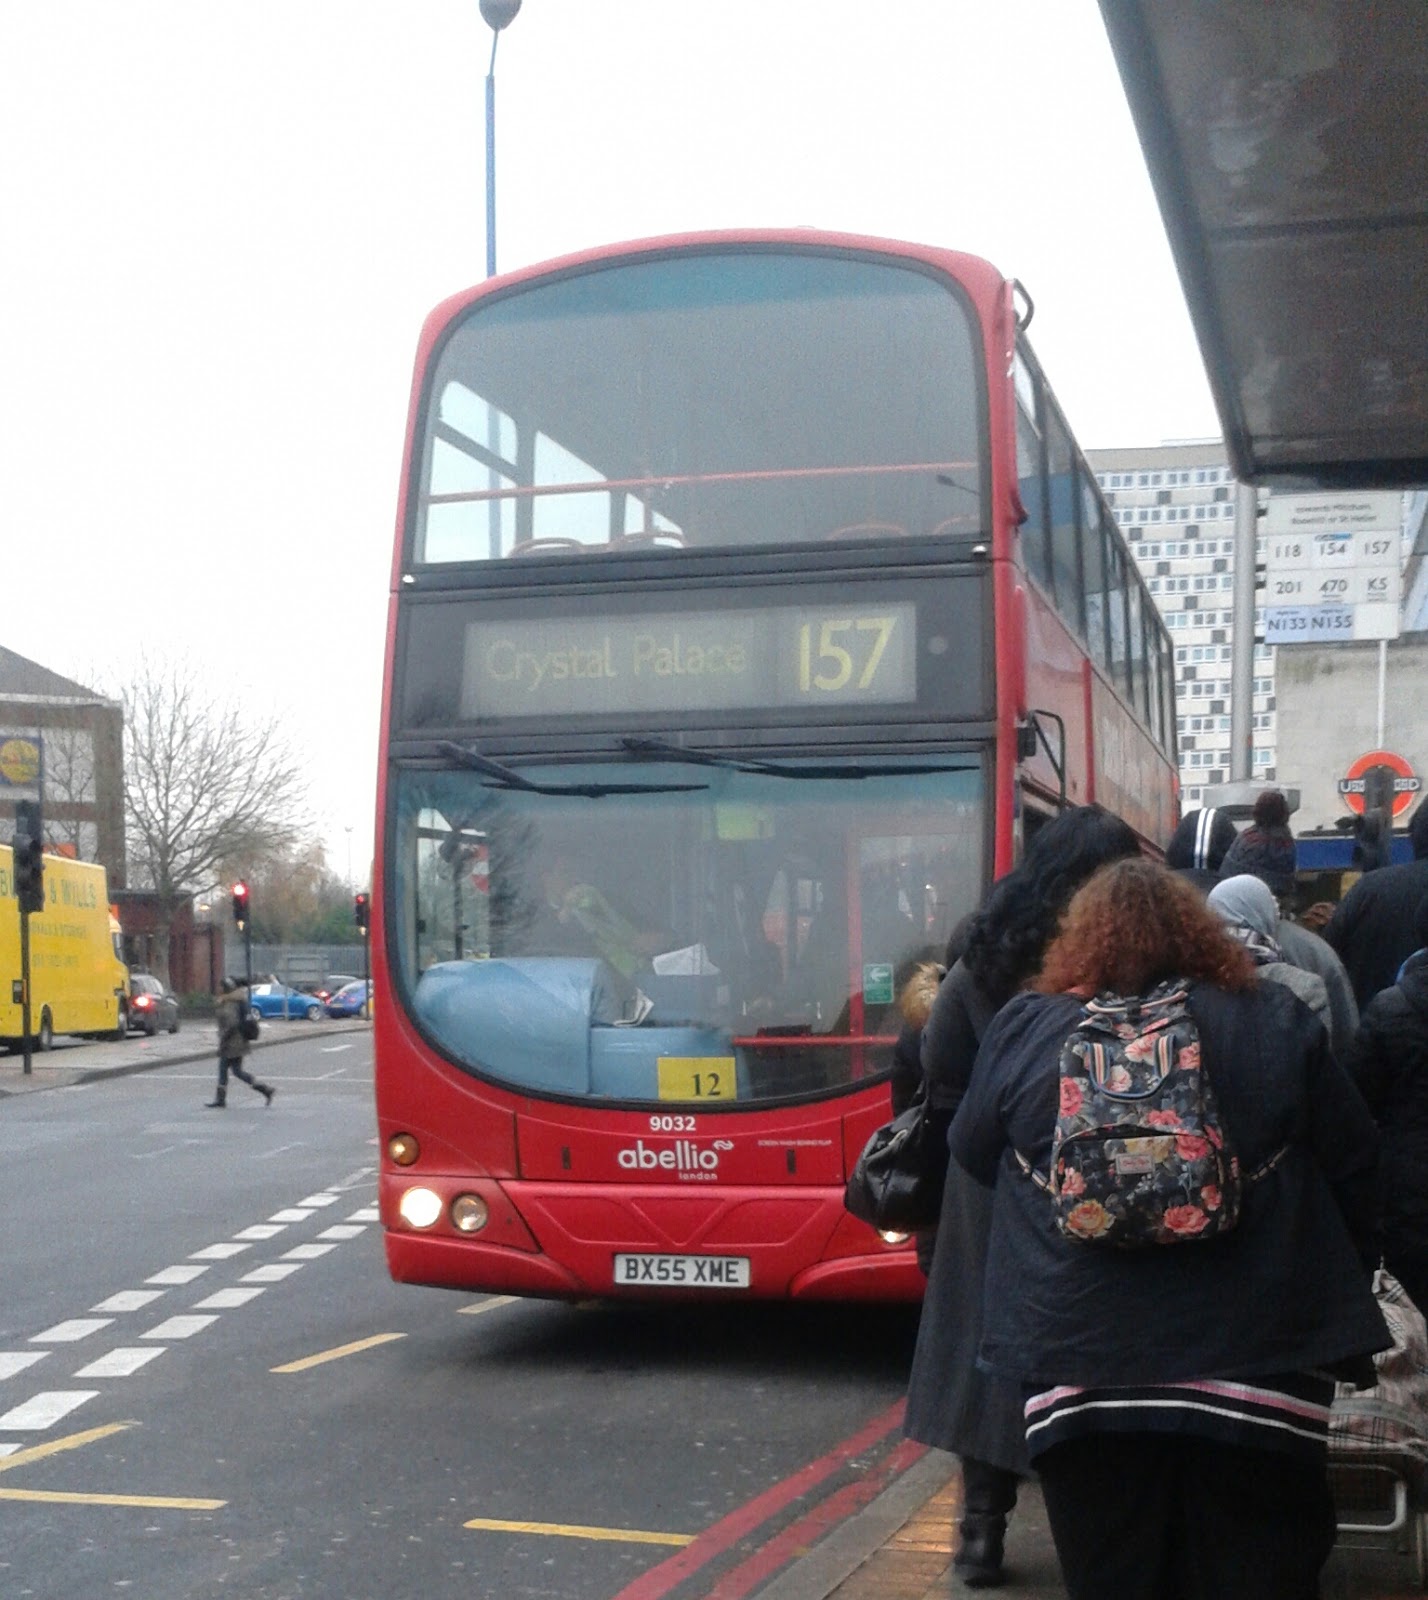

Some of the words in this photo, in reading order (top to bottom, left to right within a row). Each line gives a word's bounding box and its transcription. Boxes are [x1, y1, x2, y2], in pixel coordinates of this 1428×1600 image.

[1275, 544, 1301, 558] 118
[1320, 541, 1346, 556] 154
[1364, 541, 1391, 555] 157
[1276, 581, 1301, 594] 201
[1319, 579, 1348, 592] 470
[1367, 577, 1388, 591] K5
[1268, 618, 1307, 631] N133
[1311, 615, 1353, 628] N155
[486, 636, 617, 692] Crystal
[633, 633, 746, 677] Palace
[797, 616, 898, 692] 157
[692, 1073, 721, 1096] 12
[650, 1116, 696, 1131] 9032
[618, 1140, 719, 1169] abellio
[678, 1172, 718, 1180] london
[625, 1258, 686, 1281] BX55
[693, 1260, 740, 1283] XME
